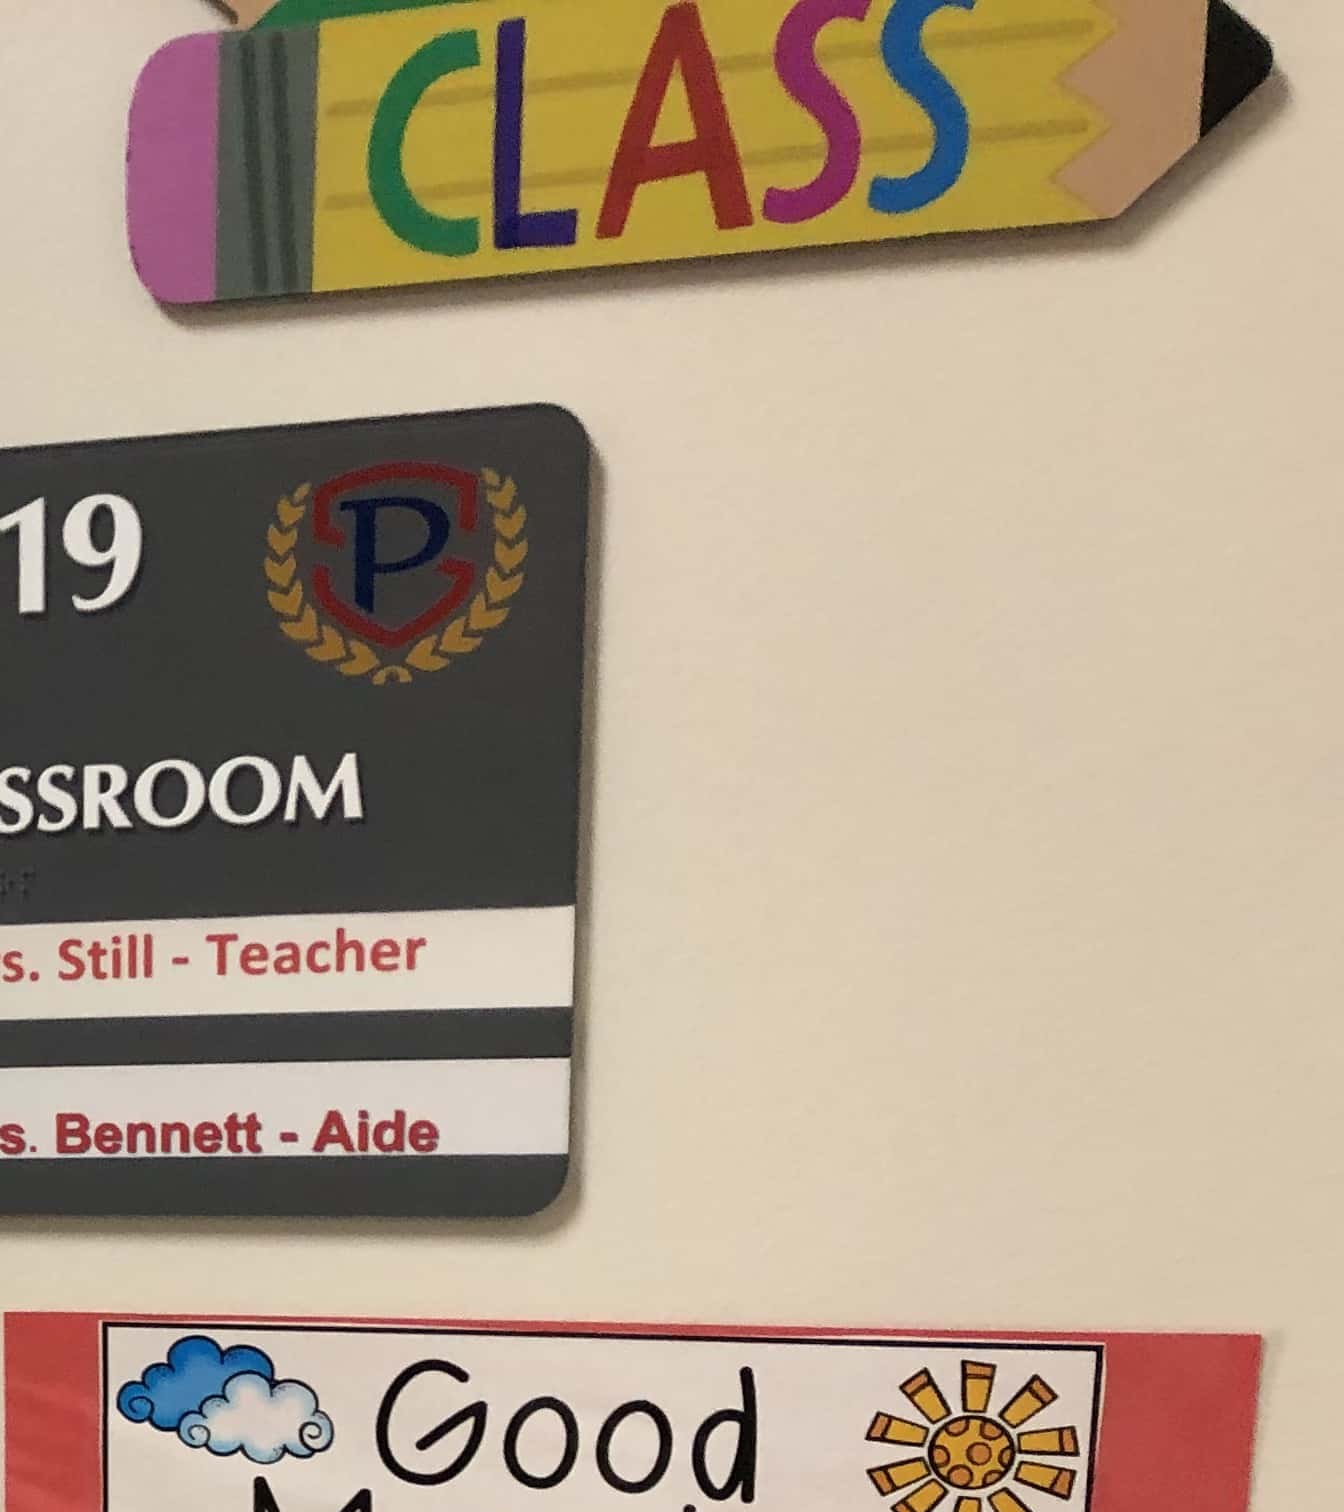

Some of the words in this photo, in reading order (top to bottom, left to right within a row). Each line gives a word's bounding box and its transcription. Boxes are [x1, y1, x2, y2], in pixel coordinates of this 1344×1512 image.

[367, 0, 975, 256] CLASS
[57, 934, 154, 981] Still
[206, 928, 427, 976] Teacher
[56, 1112, 262, 1155] Bennett
[313, 1110, 440, 1154] Aide
[376, 1360, 757, 1503] Good
